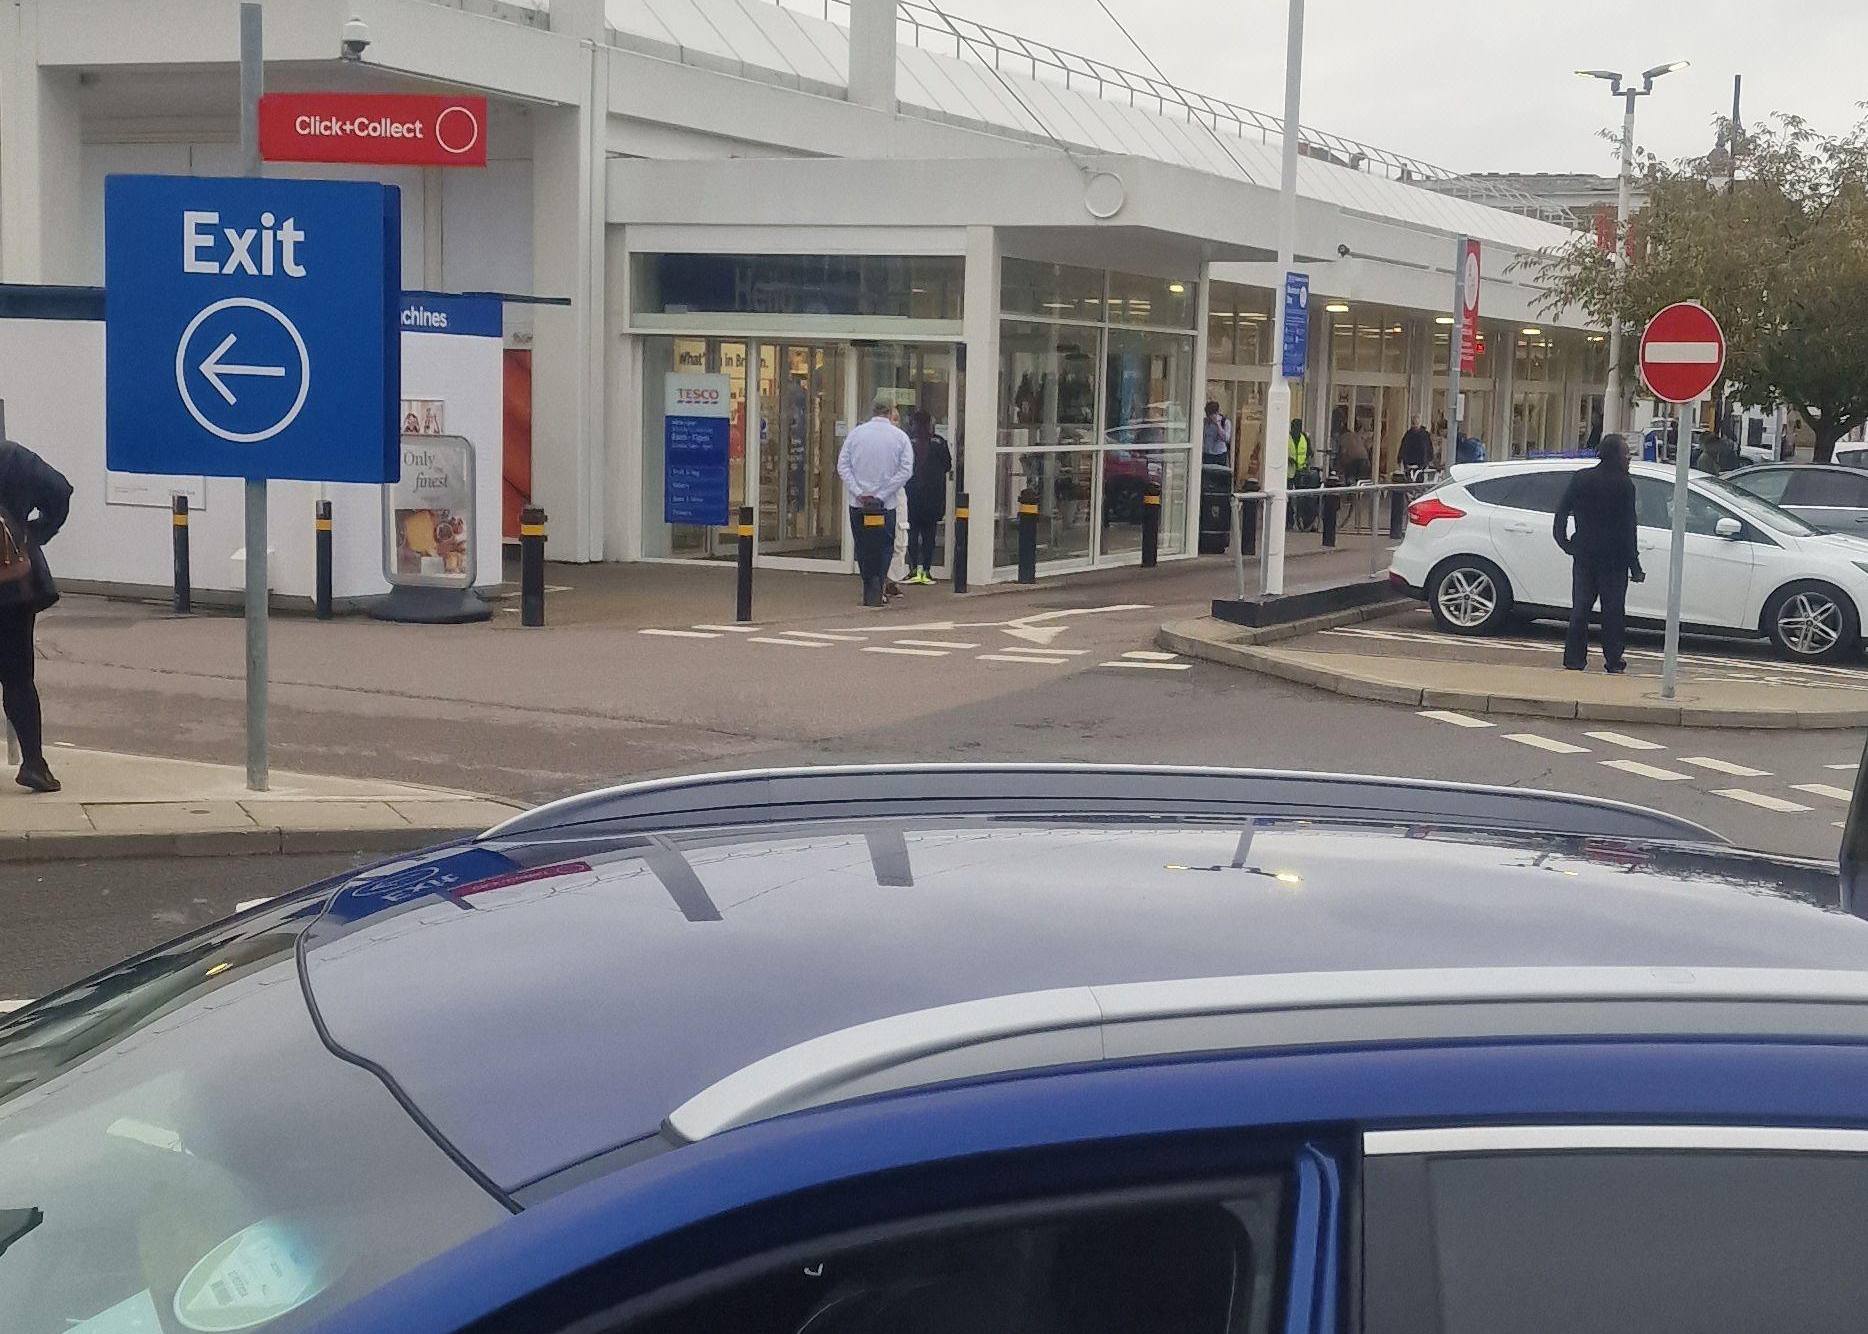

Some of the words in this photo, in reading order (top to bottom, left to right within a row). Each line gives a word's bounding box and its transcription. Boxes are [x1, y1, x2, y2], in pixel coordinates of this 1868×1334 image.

[295, 115, 424, 138] Click+Collect
[183, 210, 307, 278] Exit
[400, 305, 448, 327] chines
[676, 388, 719, 400] TESCO
[403, 451, 435, 469] Only
